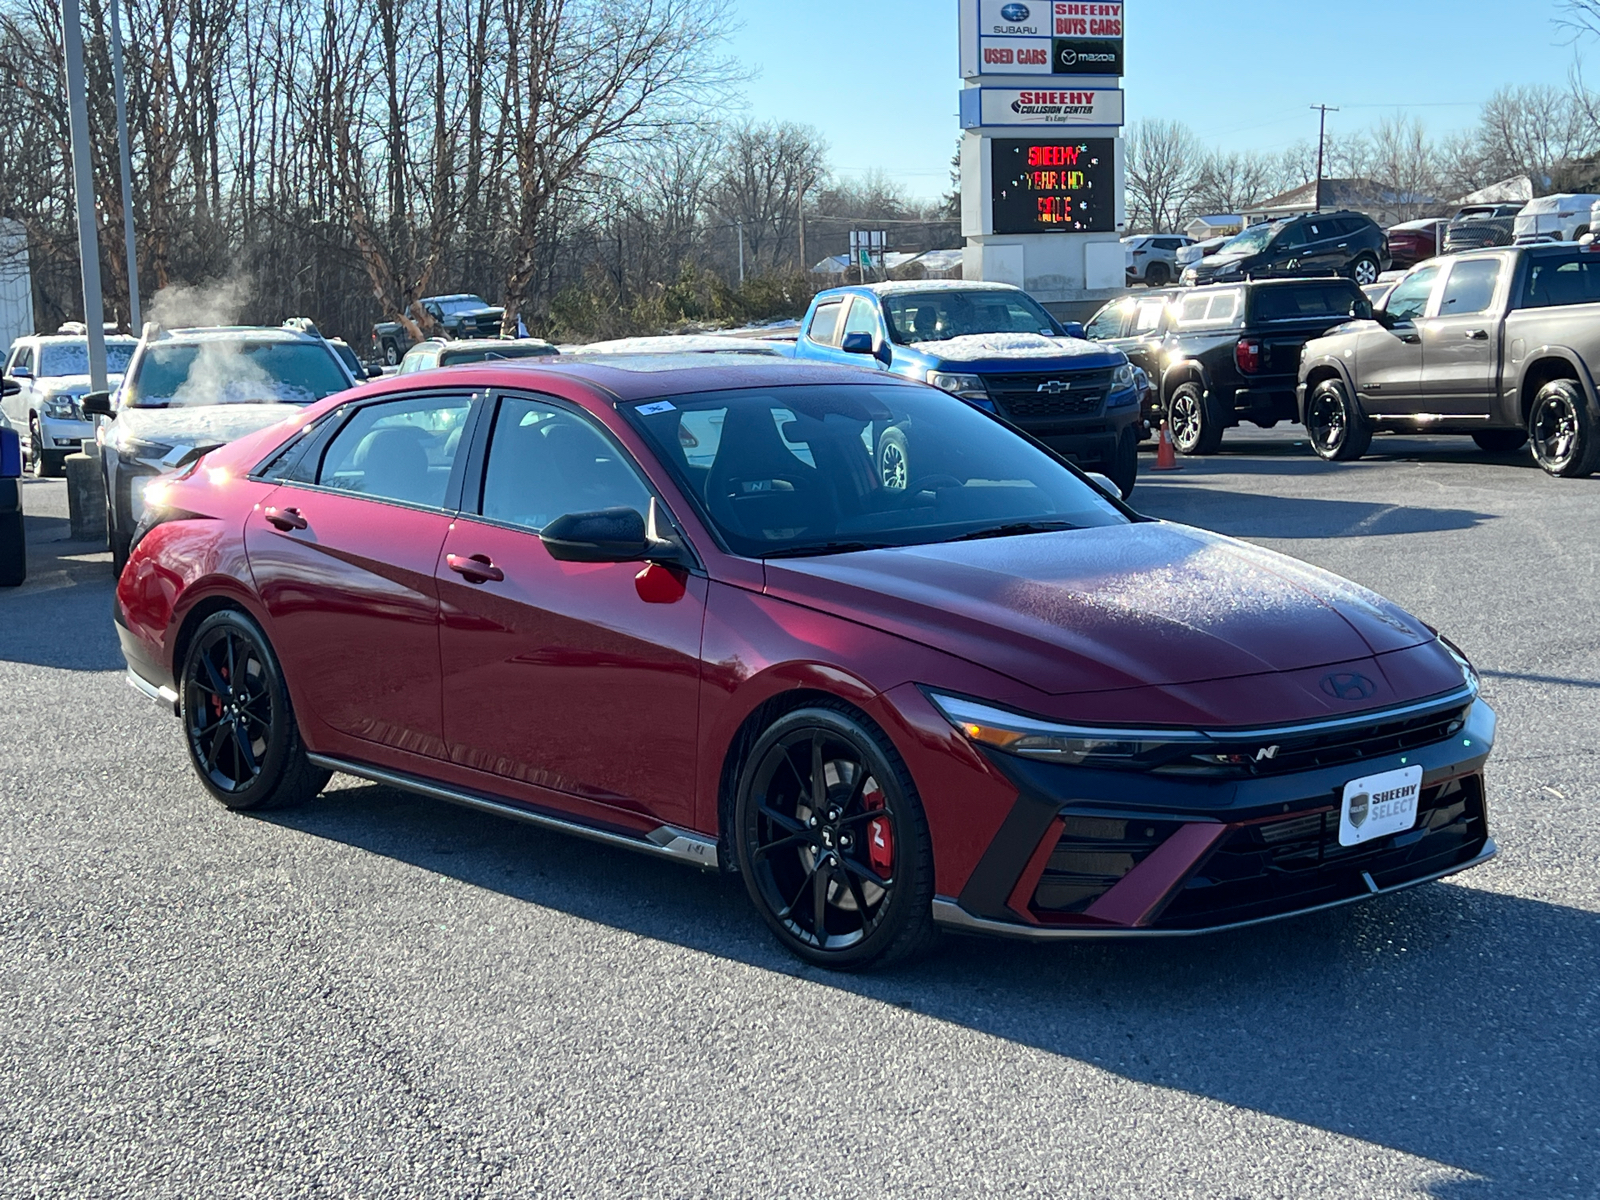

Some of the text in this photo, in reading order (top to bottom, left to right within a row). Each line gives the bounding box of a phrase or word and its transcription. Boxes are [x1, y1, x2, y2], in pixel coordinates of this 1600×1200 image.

[1055, 4, 1120, 16] SHEEHY
[994, 26, 1037, 34] SUBARU
[1056, 18, 1121, 35] BUYS CARS
[984, 48, 1047, 65] USED CARS
[1078, 53, 1115, 62] mazda
[1020, 92, 1095, 105] SHEEHY
[1021, 105, 1093, 114] COLLISION CENTER
[1372, 783, 1417, 805] SHEEHY
[1371, 796, 1415, 821] SELECT
